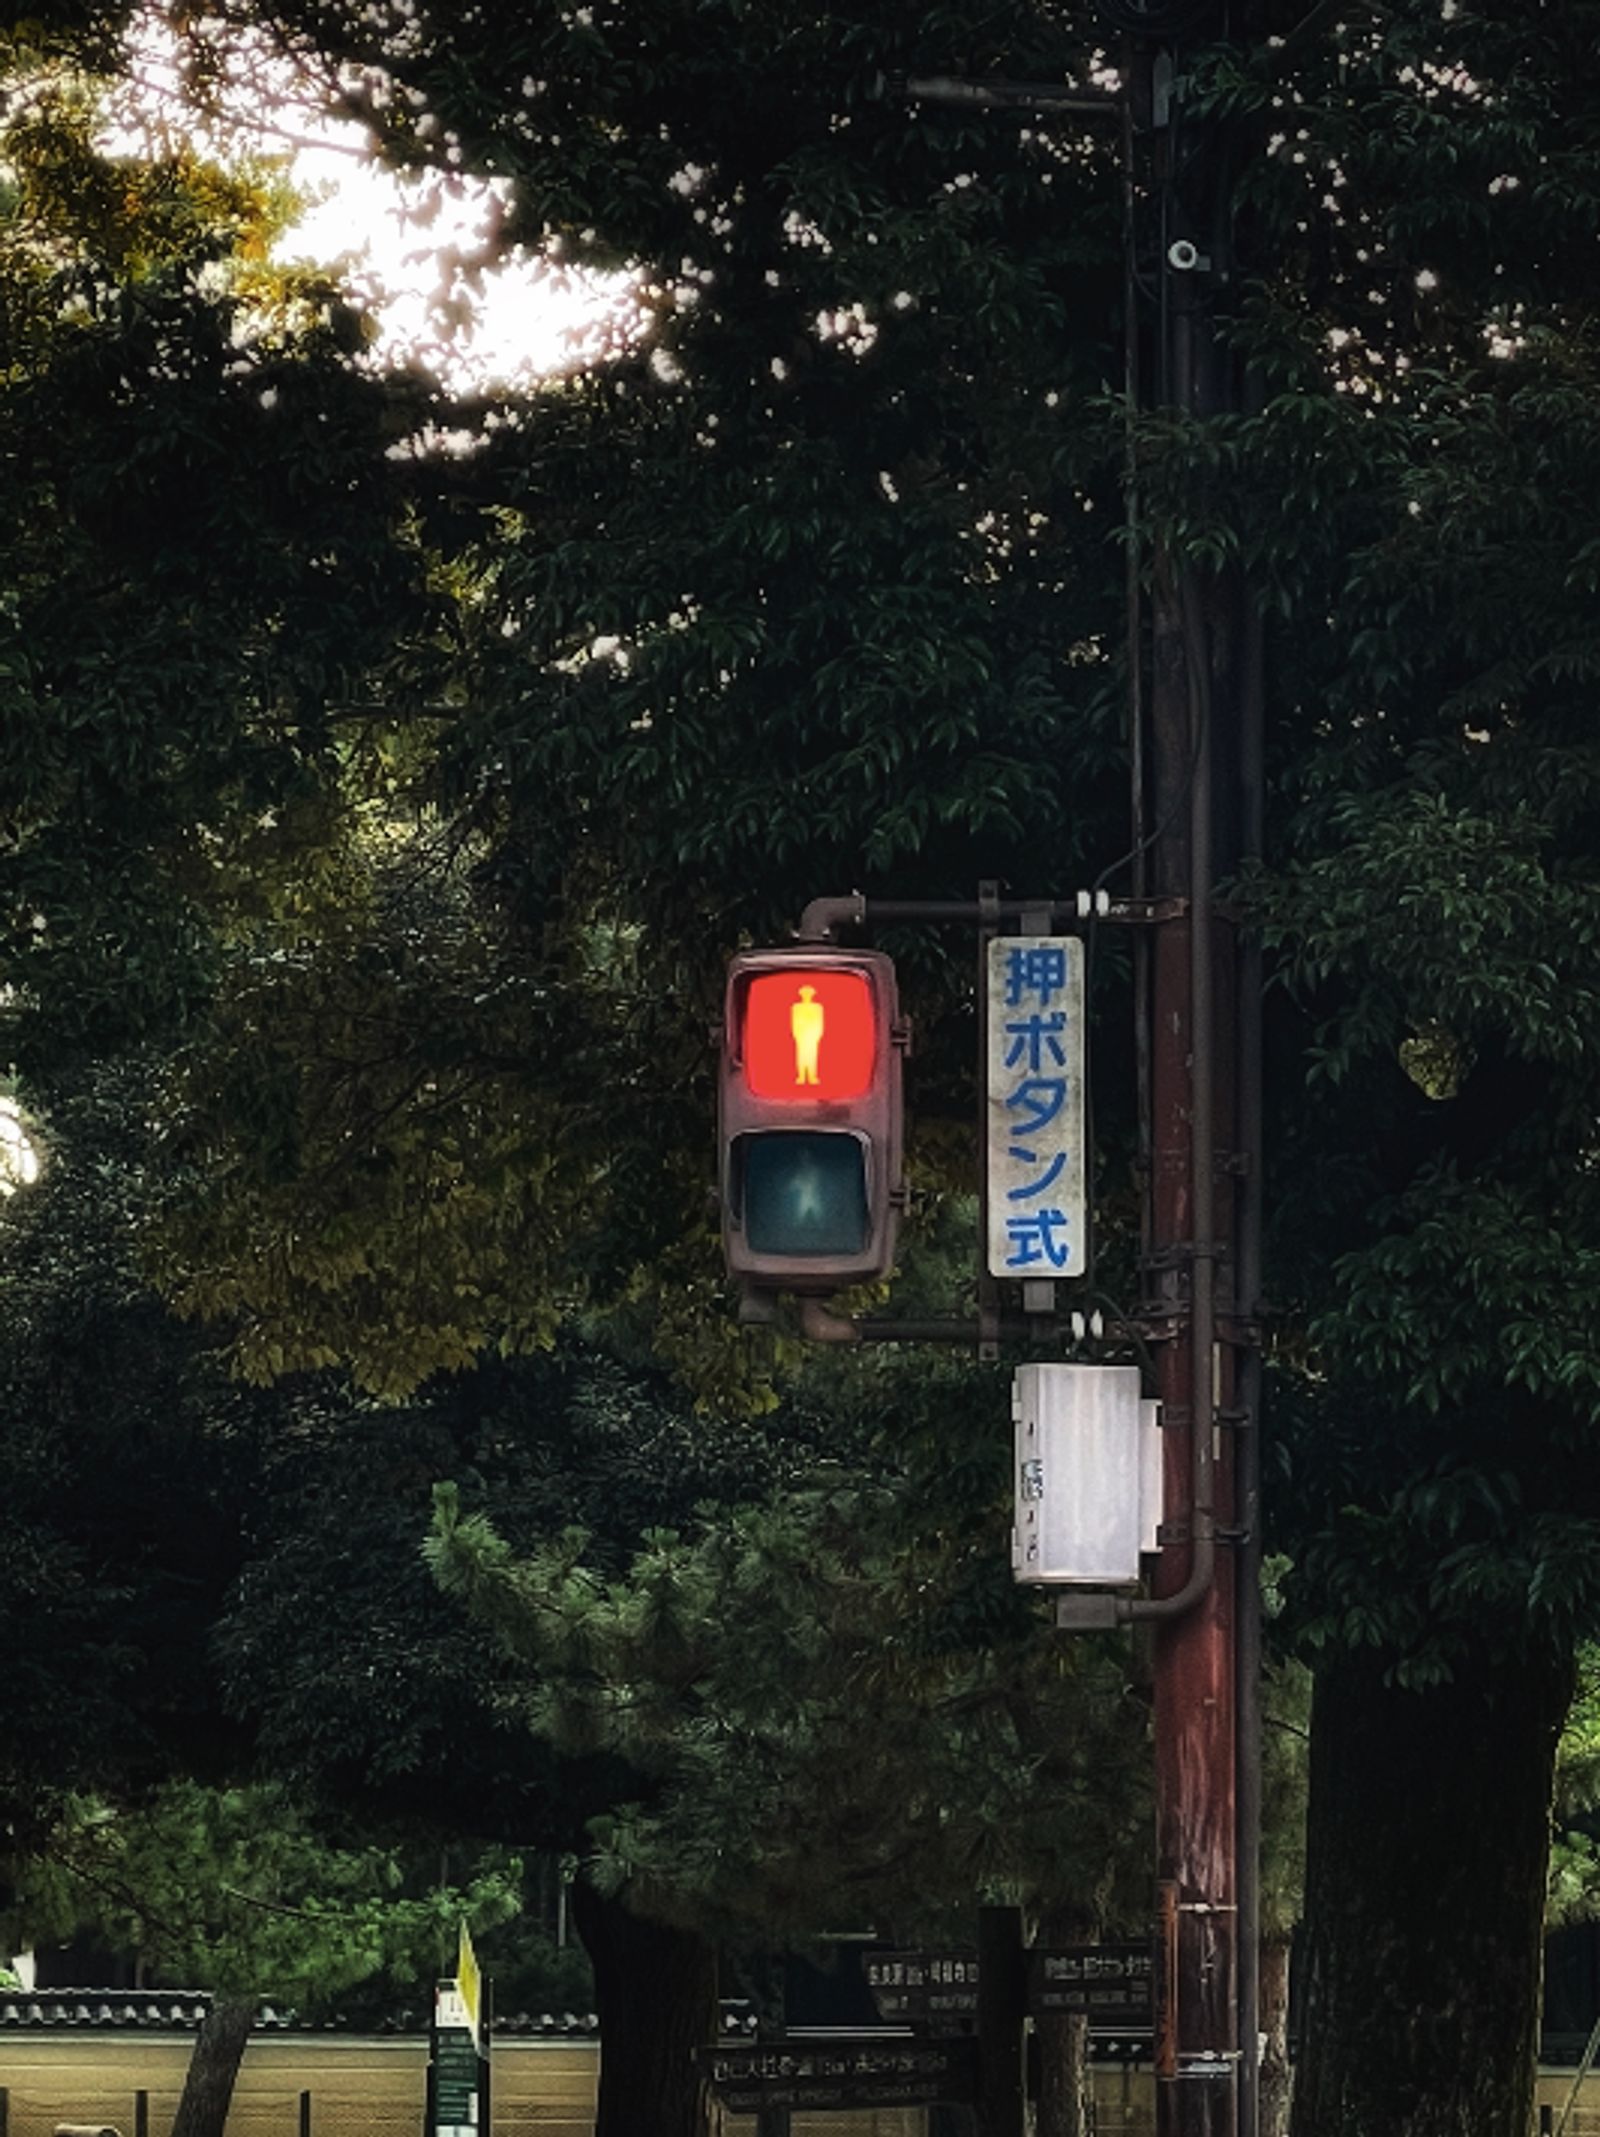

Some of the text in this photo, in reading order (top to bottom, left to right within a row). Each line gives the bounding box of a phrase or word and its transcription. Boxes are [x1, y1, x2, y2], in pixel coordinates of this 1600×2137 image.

[1004, 947, 1069, 1269] 押ボタン式
